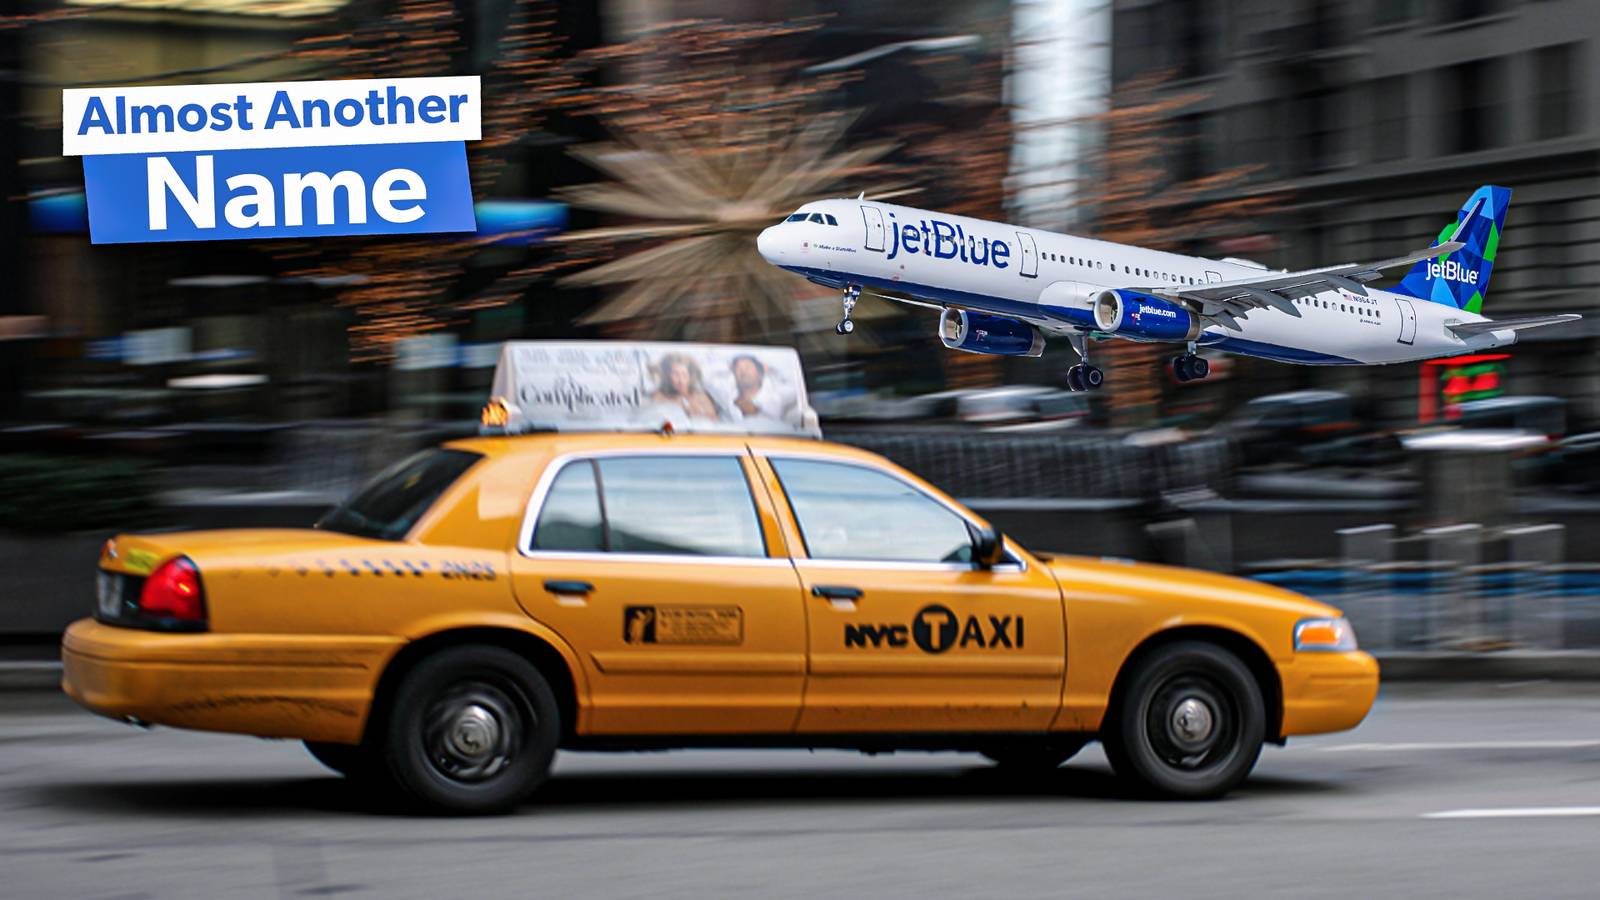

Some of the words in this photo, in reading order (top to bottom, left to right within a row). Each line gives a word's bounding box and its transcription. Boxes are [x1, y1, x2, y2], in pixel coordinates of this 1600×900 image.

[886, 212, 1011, 269] jetBlue
[1425, 258, 1478, 285] jetBlue
[1138, 303, 1177, 319] jetblue.com
[520, 384, 640, 413] Complicated
[844, 623, 909, 648] NYC
[913, 604, 1025, 655] TAXI
